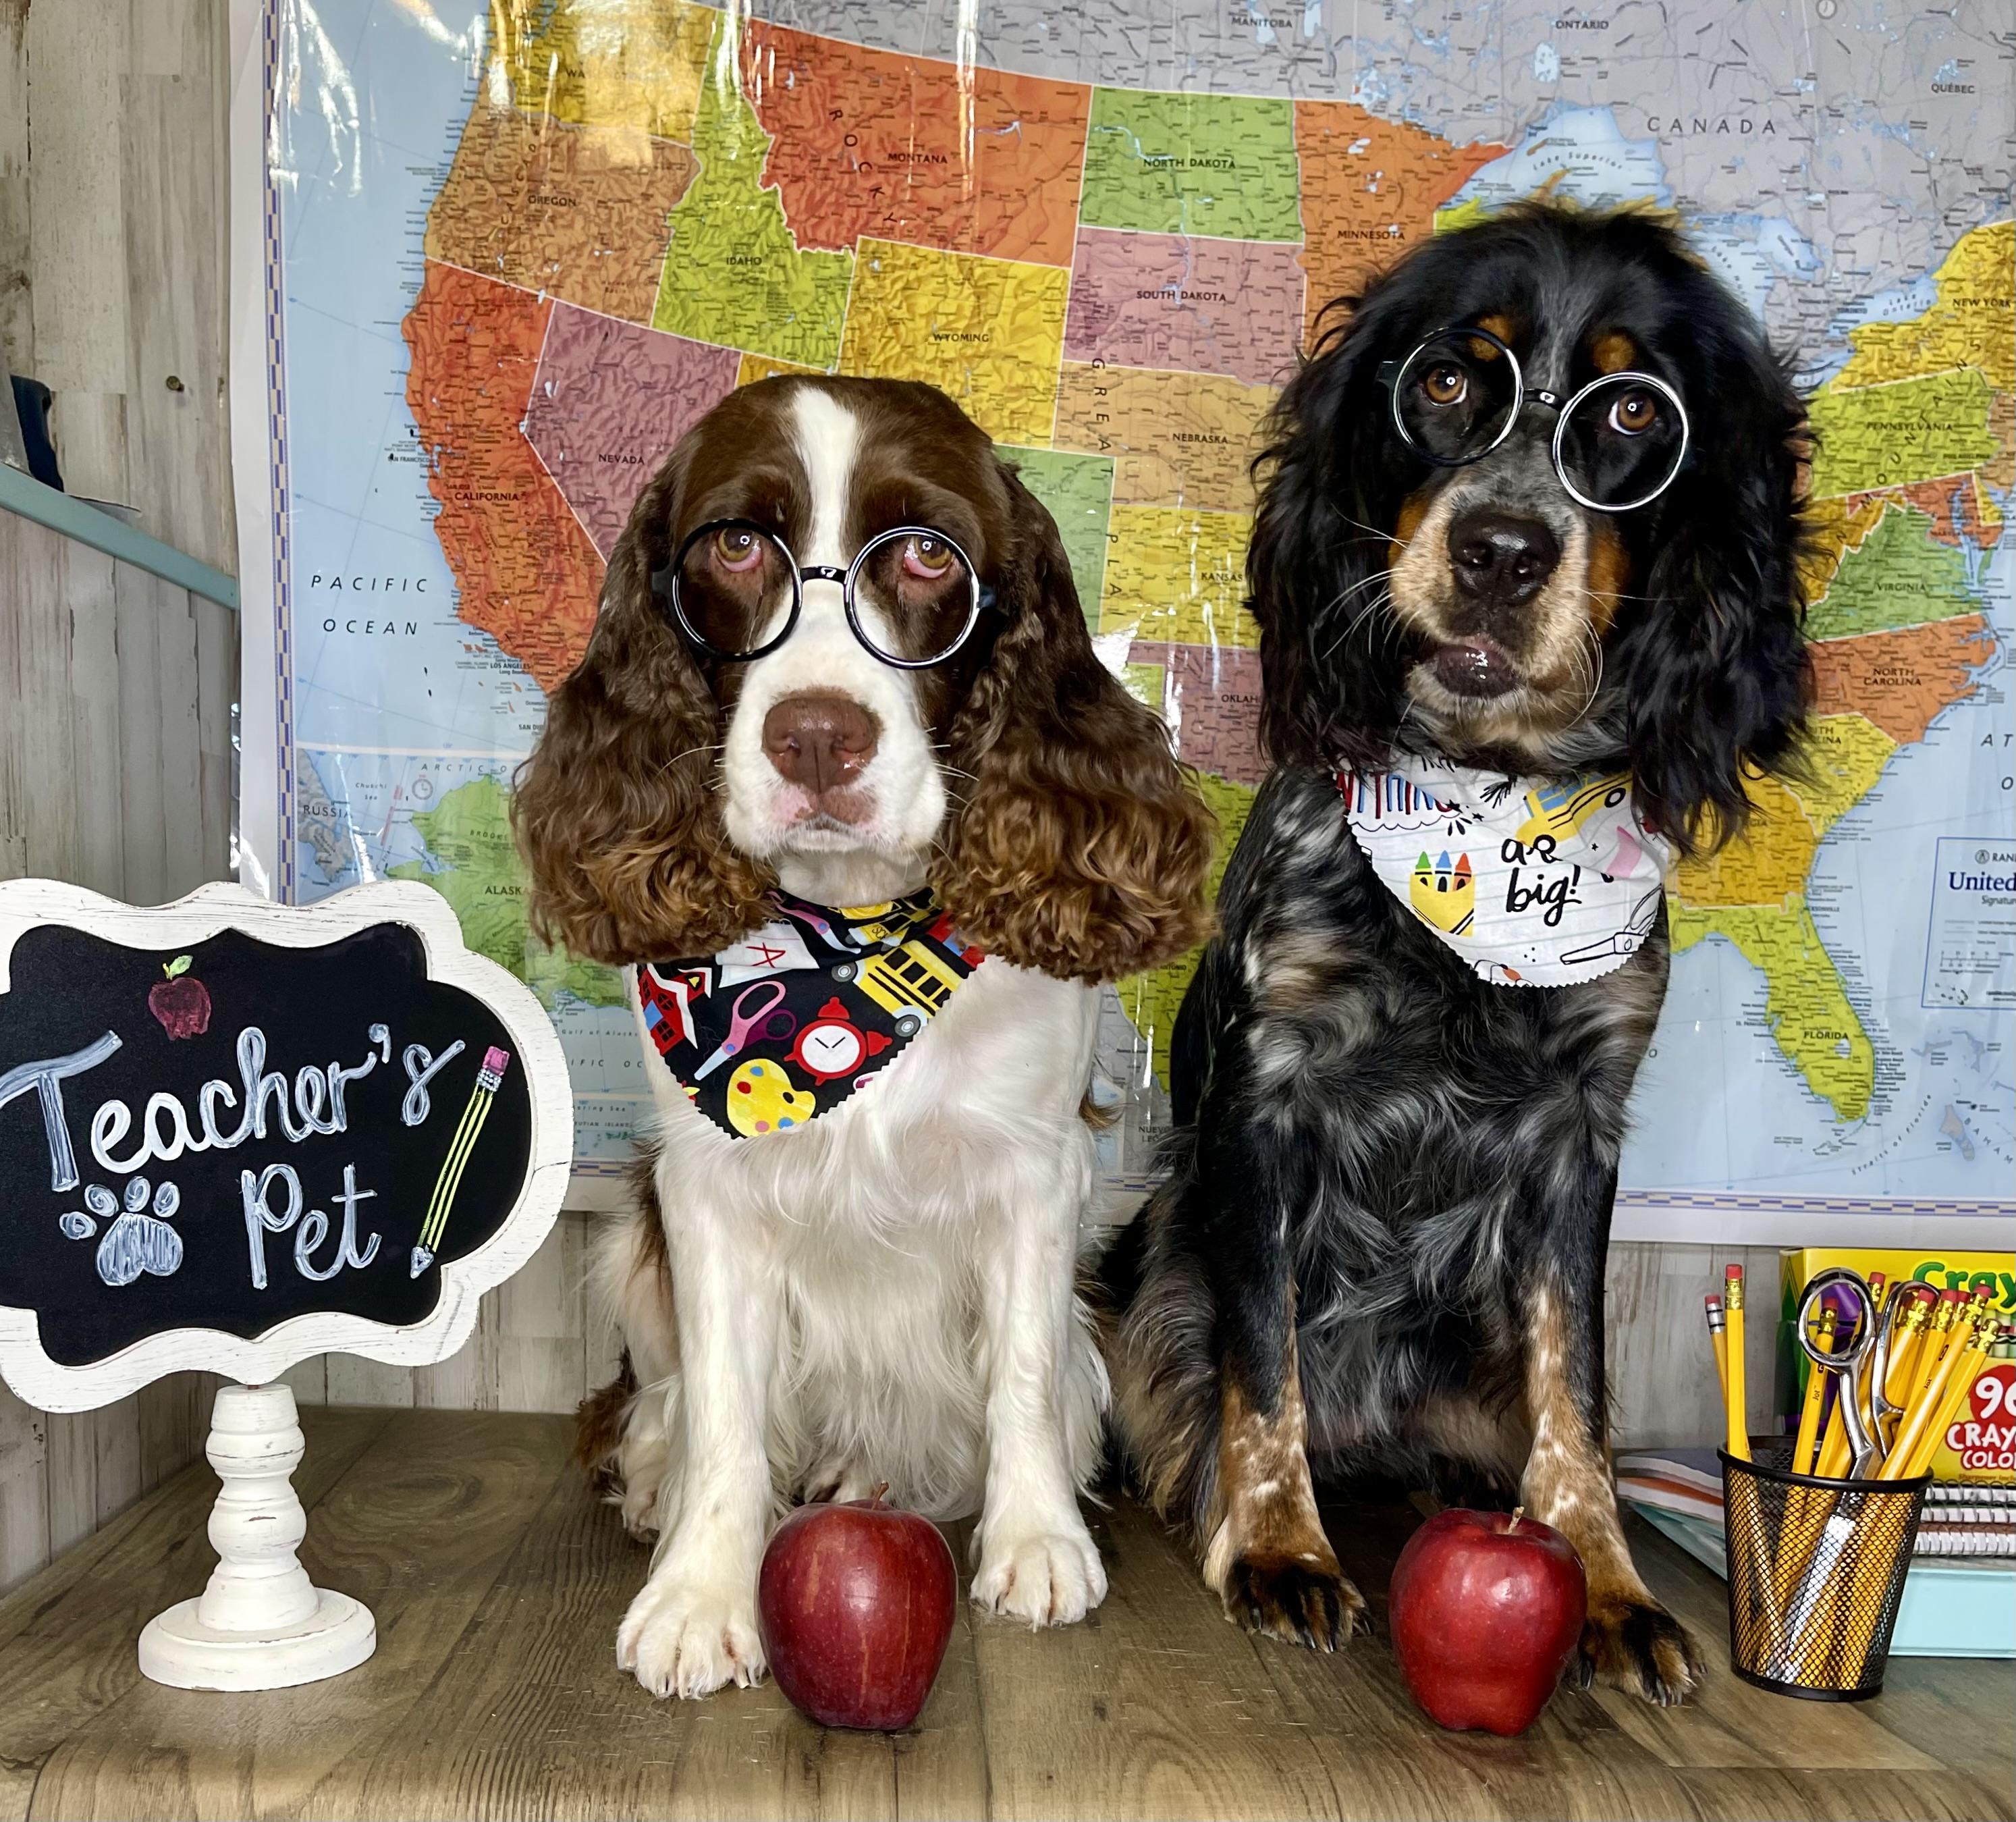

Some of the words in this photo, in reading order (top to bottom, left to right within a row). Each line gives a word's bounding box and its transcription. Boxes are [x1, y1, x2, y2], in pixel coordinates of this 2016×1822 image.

[1231, 16, 1293, 28] MANITOBA
[1555, 20, 1609, 30] ONTARIO
[1931, 82, 1976, 95] QUÉBEC
[1647, 117, 1776, 134] CANADA
[888, 153, 948, 164] MONTANA
[1143, 158, 1185, 168] NORTH
[1189, 159, 1236, 169] DAKOTA
[527, 194, 577, 207] OREGON
[1337, 230, 1406, 241] MINNESOTA
[726, 257, 763, 266] IDAHO
[1136, 290, 1176, 300] SOUTH
[1180, 291, 1227, 302] DAKOTA
[1953, 298, 1981, 307] NEW
[1983, 298, 2011, 309] YORK
[932, 333, 990, 343] WYOMING
[1865, 421, 1954, 432] PENNSYLVANIA
[1172, 432, 1228, 444] NEBRASKA
[598, 453, 645, 465] NEVADA
[454, 491, 520, 502] CALIFORNIA
[1201, 572, 1243, 582] KANSAS
[311, 574, 427, 592] PACIFIC
[1876, 582, 1926, 591] VIRGINIA
[323, 618, 418, 635] OCEAN
[1873, 668, 1915, 676] NORTH
[1863, 676, 1922, 687] CAROLINA
[420, 763, 485, 773] ARCTIC
[1949, 871, 2016, 892] United
[1506, 864, 1582, 927] big!
[1803, 1030, 1849, 1040] FLORIDA
[0, 1023, 466, 1192] Teacher's
[240, 1162, 382, 1290] Pet
[1962, 1449, 2016, 1470] COLO
